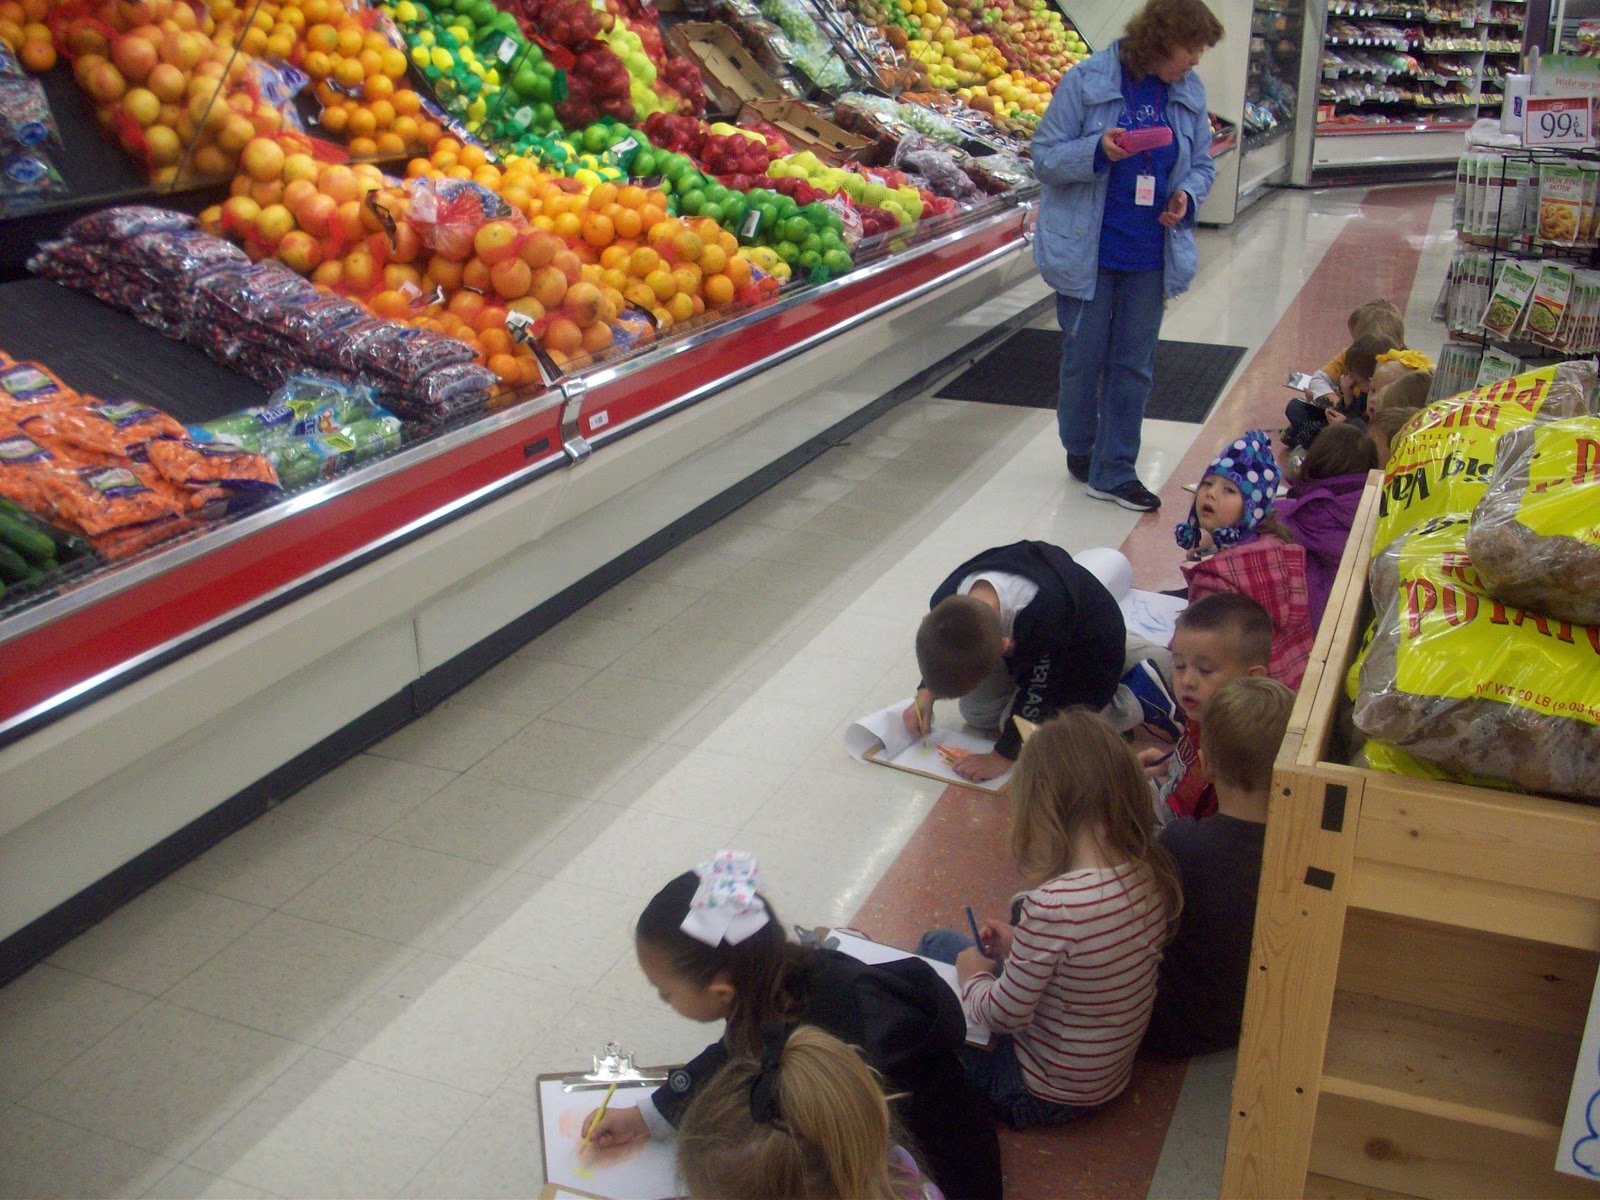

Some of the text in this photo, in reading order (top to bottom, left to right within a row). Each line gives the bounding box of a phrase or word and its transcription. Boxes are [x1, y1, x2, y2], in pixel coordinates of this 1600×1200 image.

[1495, 684, 1515, 697] WT
[1519, 690, 1532, 702] 20
[1535, 694, 1551, 708] LB
